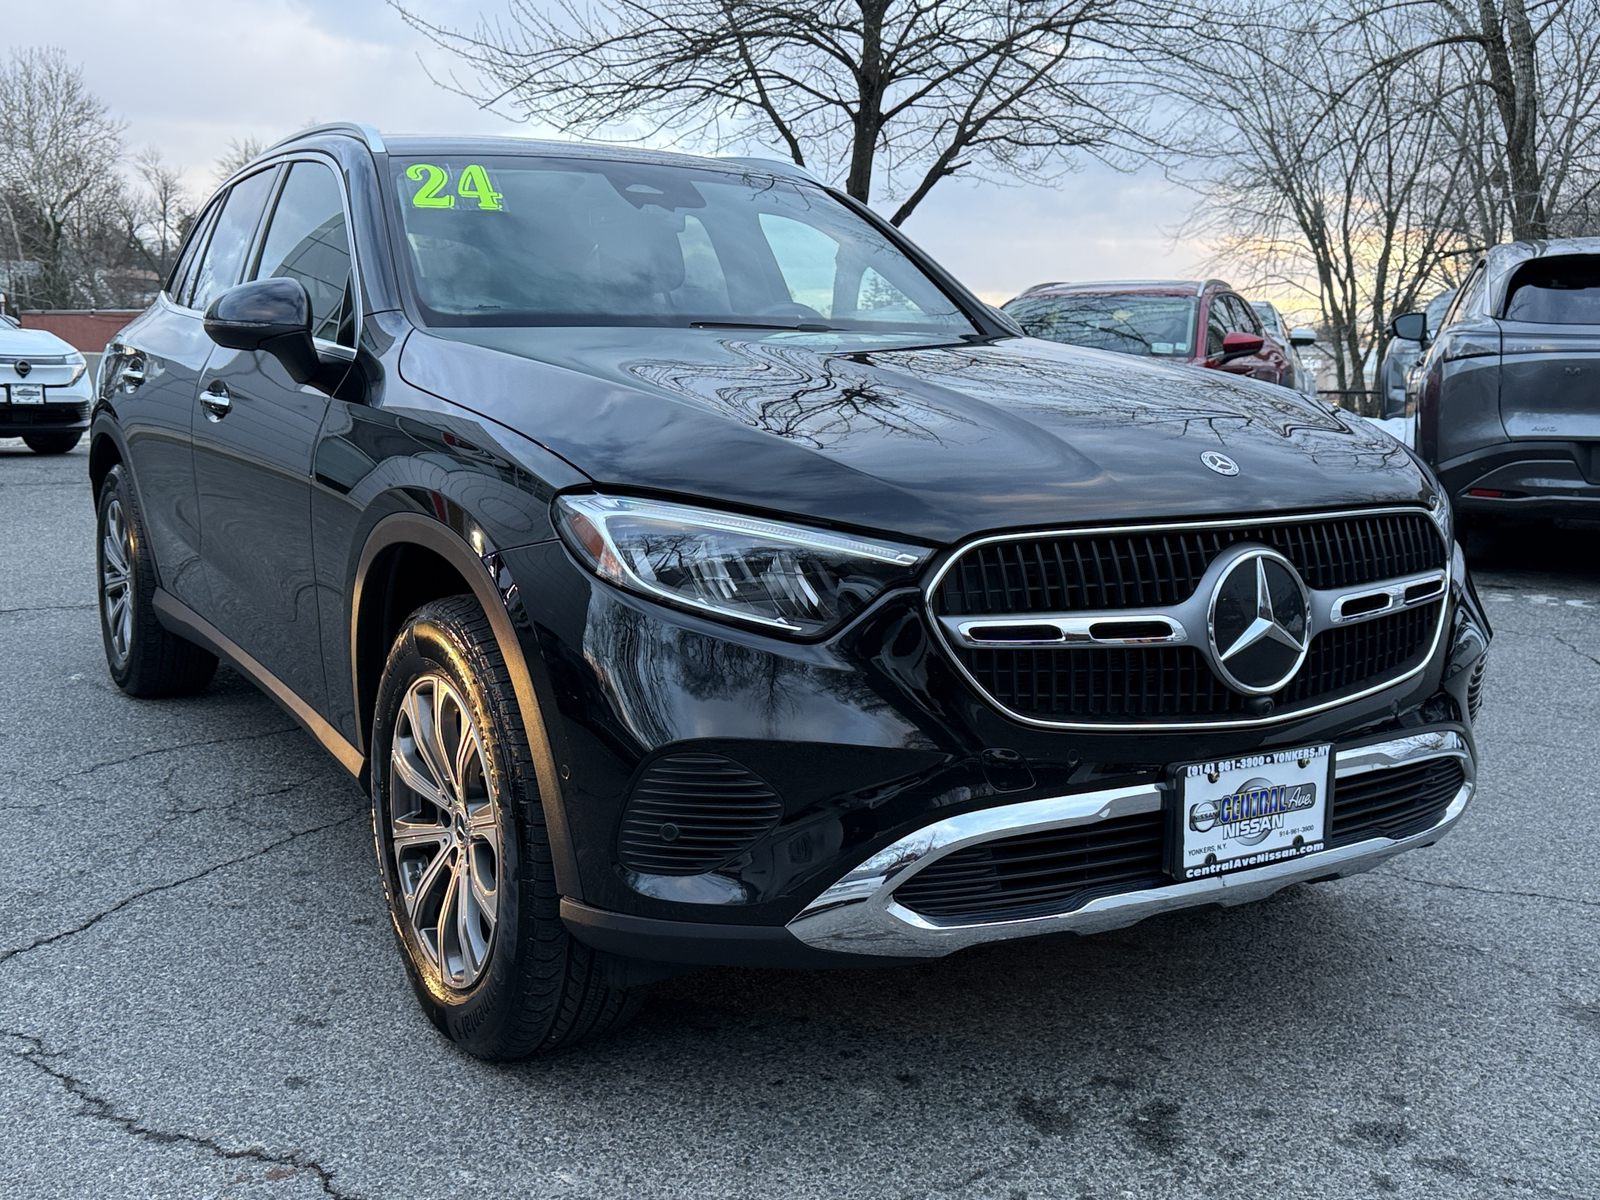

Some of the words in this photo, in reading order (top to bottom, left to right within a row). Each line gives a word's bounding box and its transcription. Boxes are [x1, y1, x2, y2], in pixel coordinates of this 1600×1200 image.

[406, 163, 503, 210] 24
[1218, 756, 1265, 772] 961-3900
[1193, 811, 1218, 820] NISSAN
[1220, 785, 1287, 823] CENTRAL
[1288, 787, 1313, 809] Ave.
[1223, 813, 1284, 840] NISSAN
[1186, 842, 1324, 878] CentralAveNissan.com
